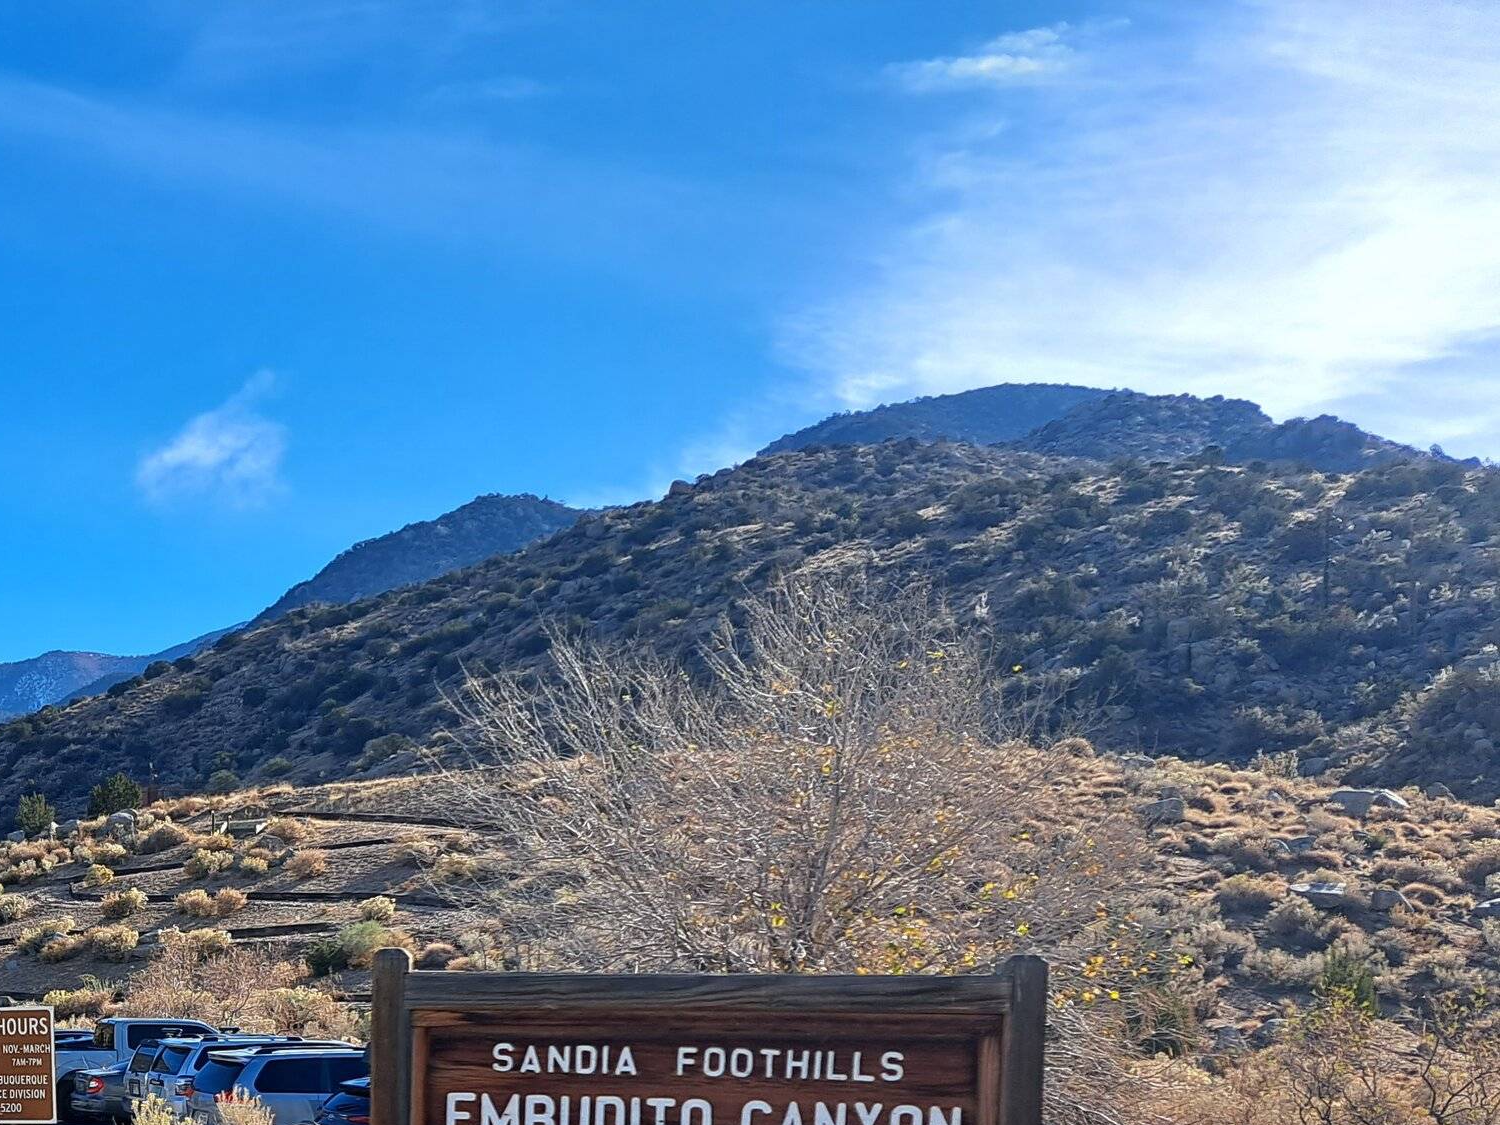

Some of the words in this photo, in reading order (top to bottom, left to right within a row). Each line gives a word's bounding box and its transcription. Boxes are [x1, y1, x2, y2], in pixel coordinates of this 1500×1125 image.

[12, 1058, 42, 1066] 7AM-7PM
[492, 1042, 637, 1076] SANDIA
[676, 1046, 904, 1082] FOOTHILLS
[10, 1089, 45, 1099] DIVISION
